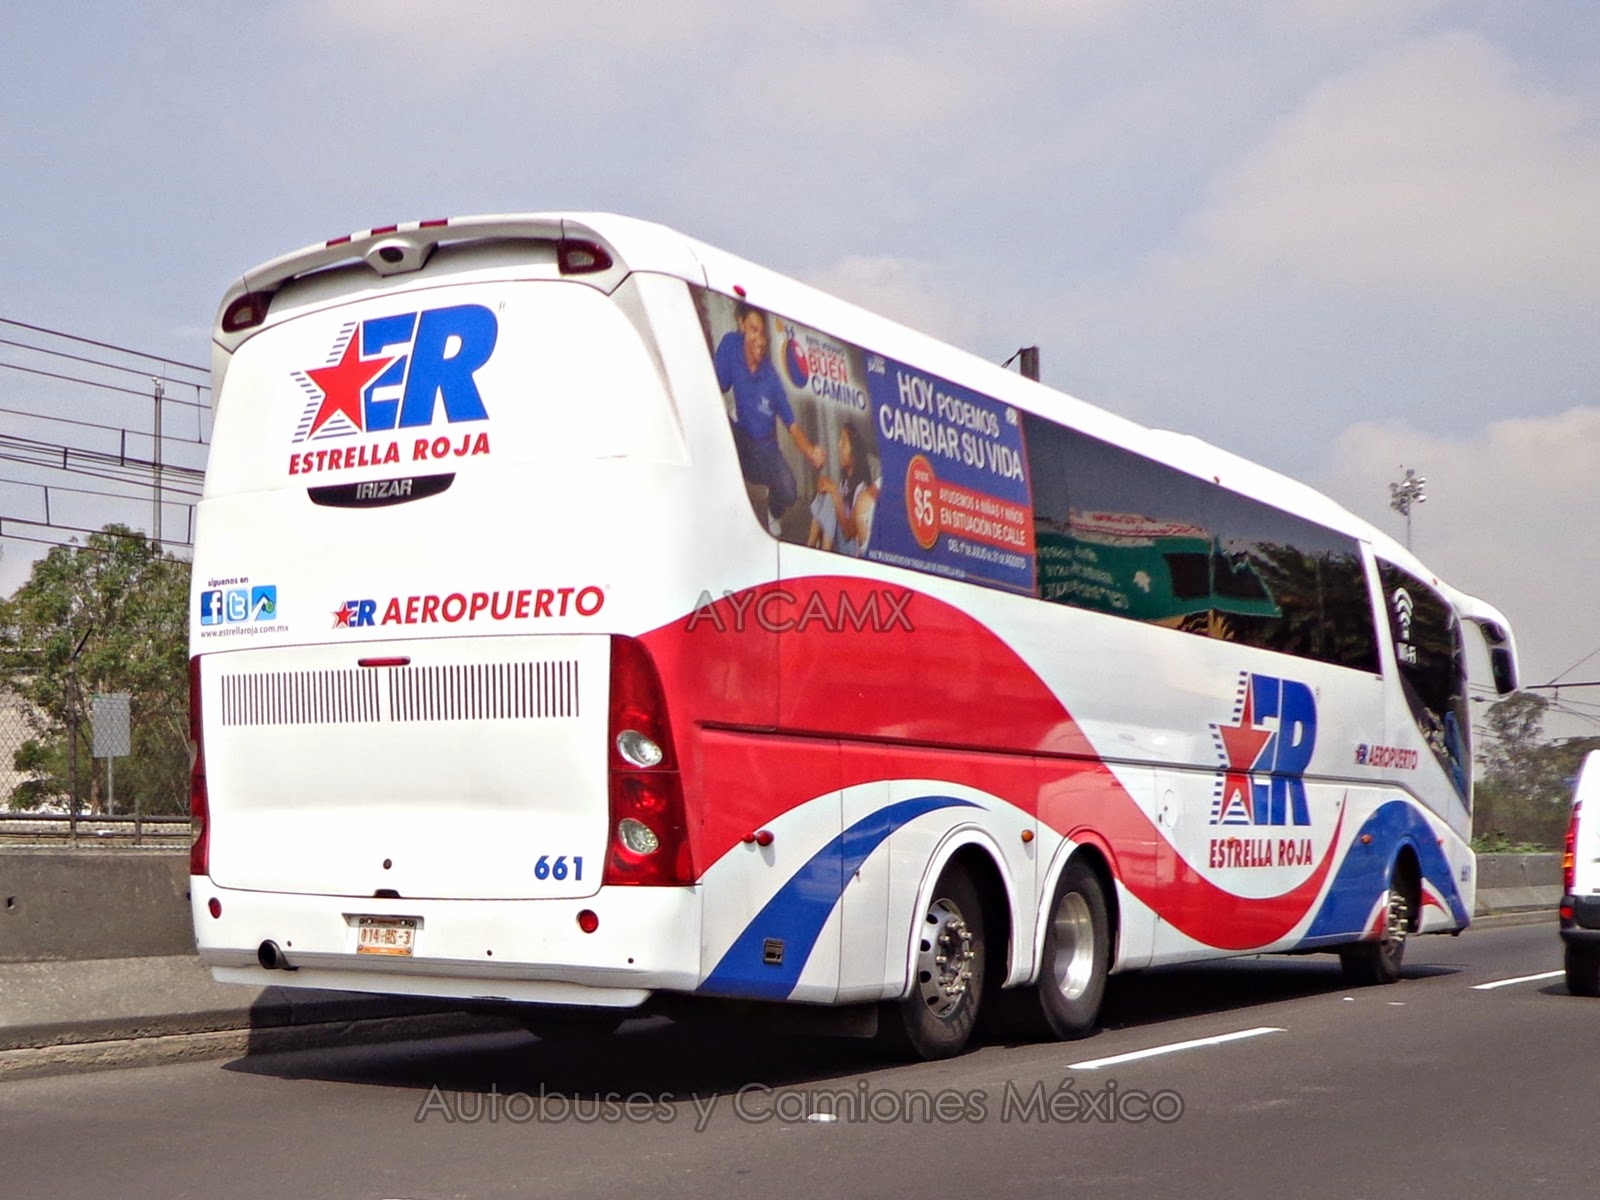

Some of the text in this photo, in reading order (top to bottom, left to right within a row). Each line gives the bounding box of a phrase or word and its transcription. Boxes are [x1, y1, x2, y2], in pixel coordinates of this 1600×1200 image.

[811, 375, 867, 410] CAMINO
[897, 371, 933, 415] HOY
[936, 392, 1000, 438] PODEMOS
[289, 432, 490, 475] ESTRELLA ROJA
[879, 404, 962, 462] CAMBIAR
[961, 432, 986, 469] SU
[986, 440, 1025, 483] VIDA
[356, 478, 412, 500] IRIZAR
[913, 485, 934, 527] $5
[1002, 524, 1026, 547] CALLE
[208, 576, 249, 588] síguenos en
[380, 585, 605, 626] AEROPUERTO
[201, 625, 289, 639] www.estrellaroja.com.mx
[534, 855, 583, 881] 661
[1209, 838, 1313, 868] ESTRELLA ROJA
